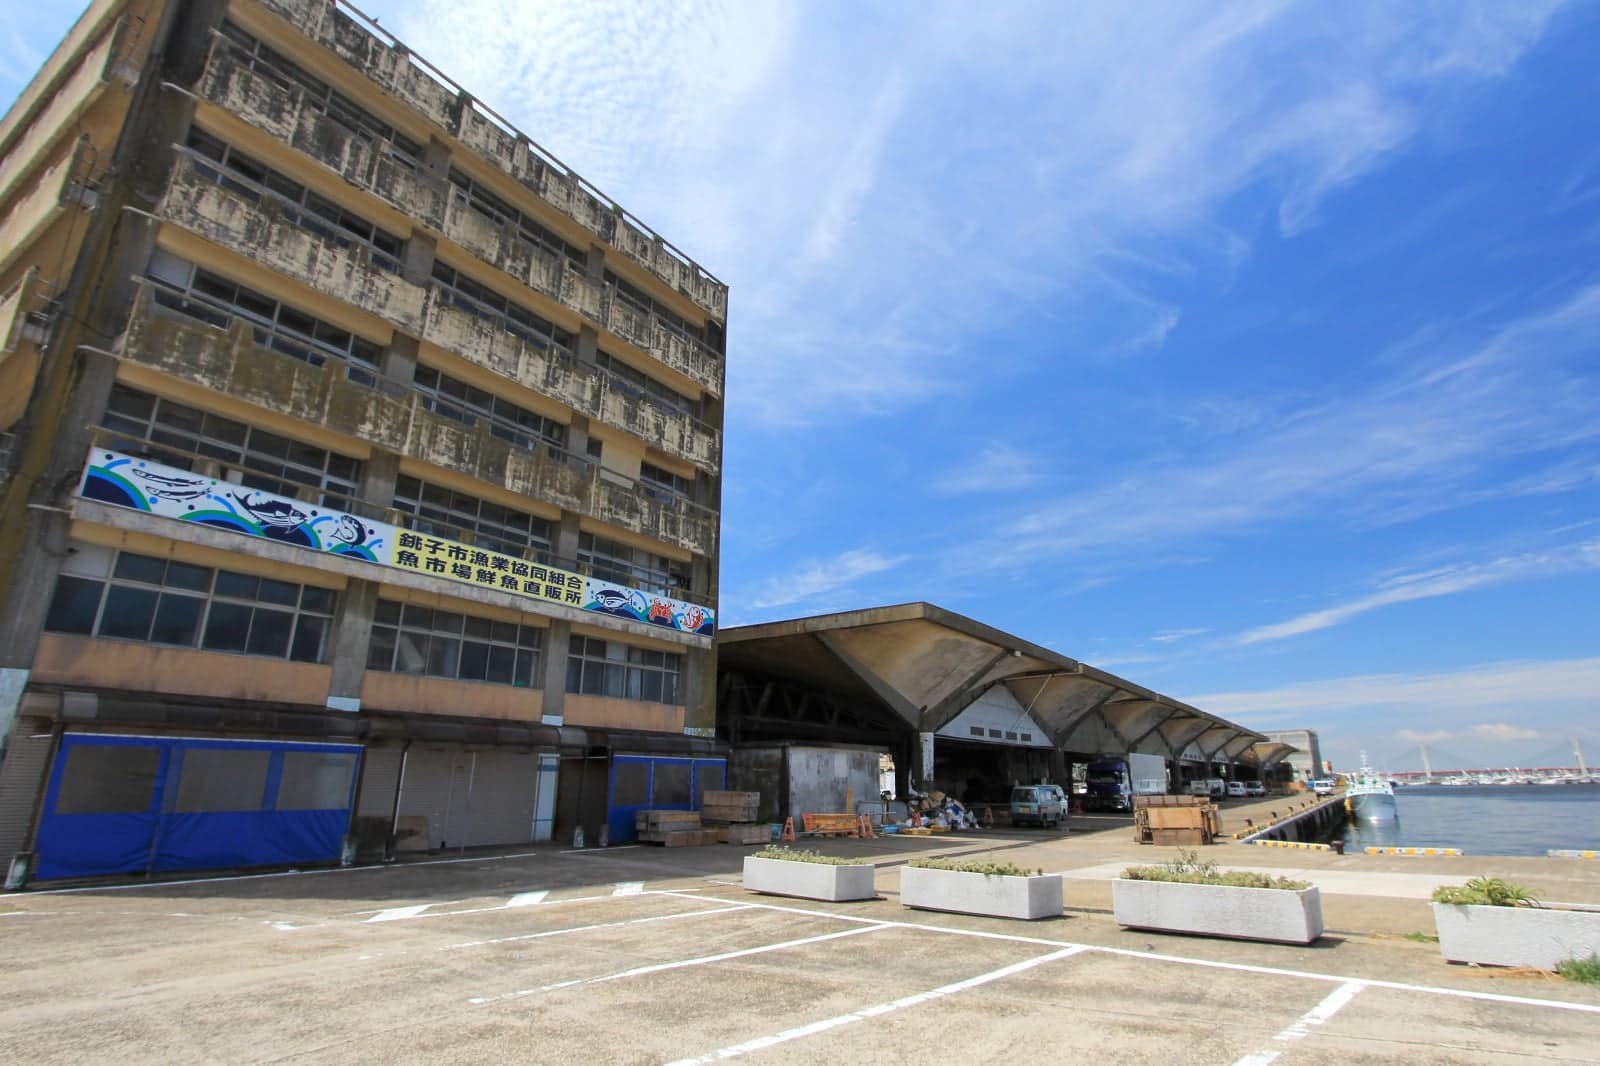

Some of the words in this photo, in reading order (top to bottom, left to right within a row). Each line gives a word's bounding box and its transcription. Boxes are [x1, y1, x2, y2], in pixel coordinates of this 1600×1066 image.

[397, 551, 582, 605] 魚市場鮮魚直販所
[399, 532, 583, 590] 銚子市漁業協同組合
